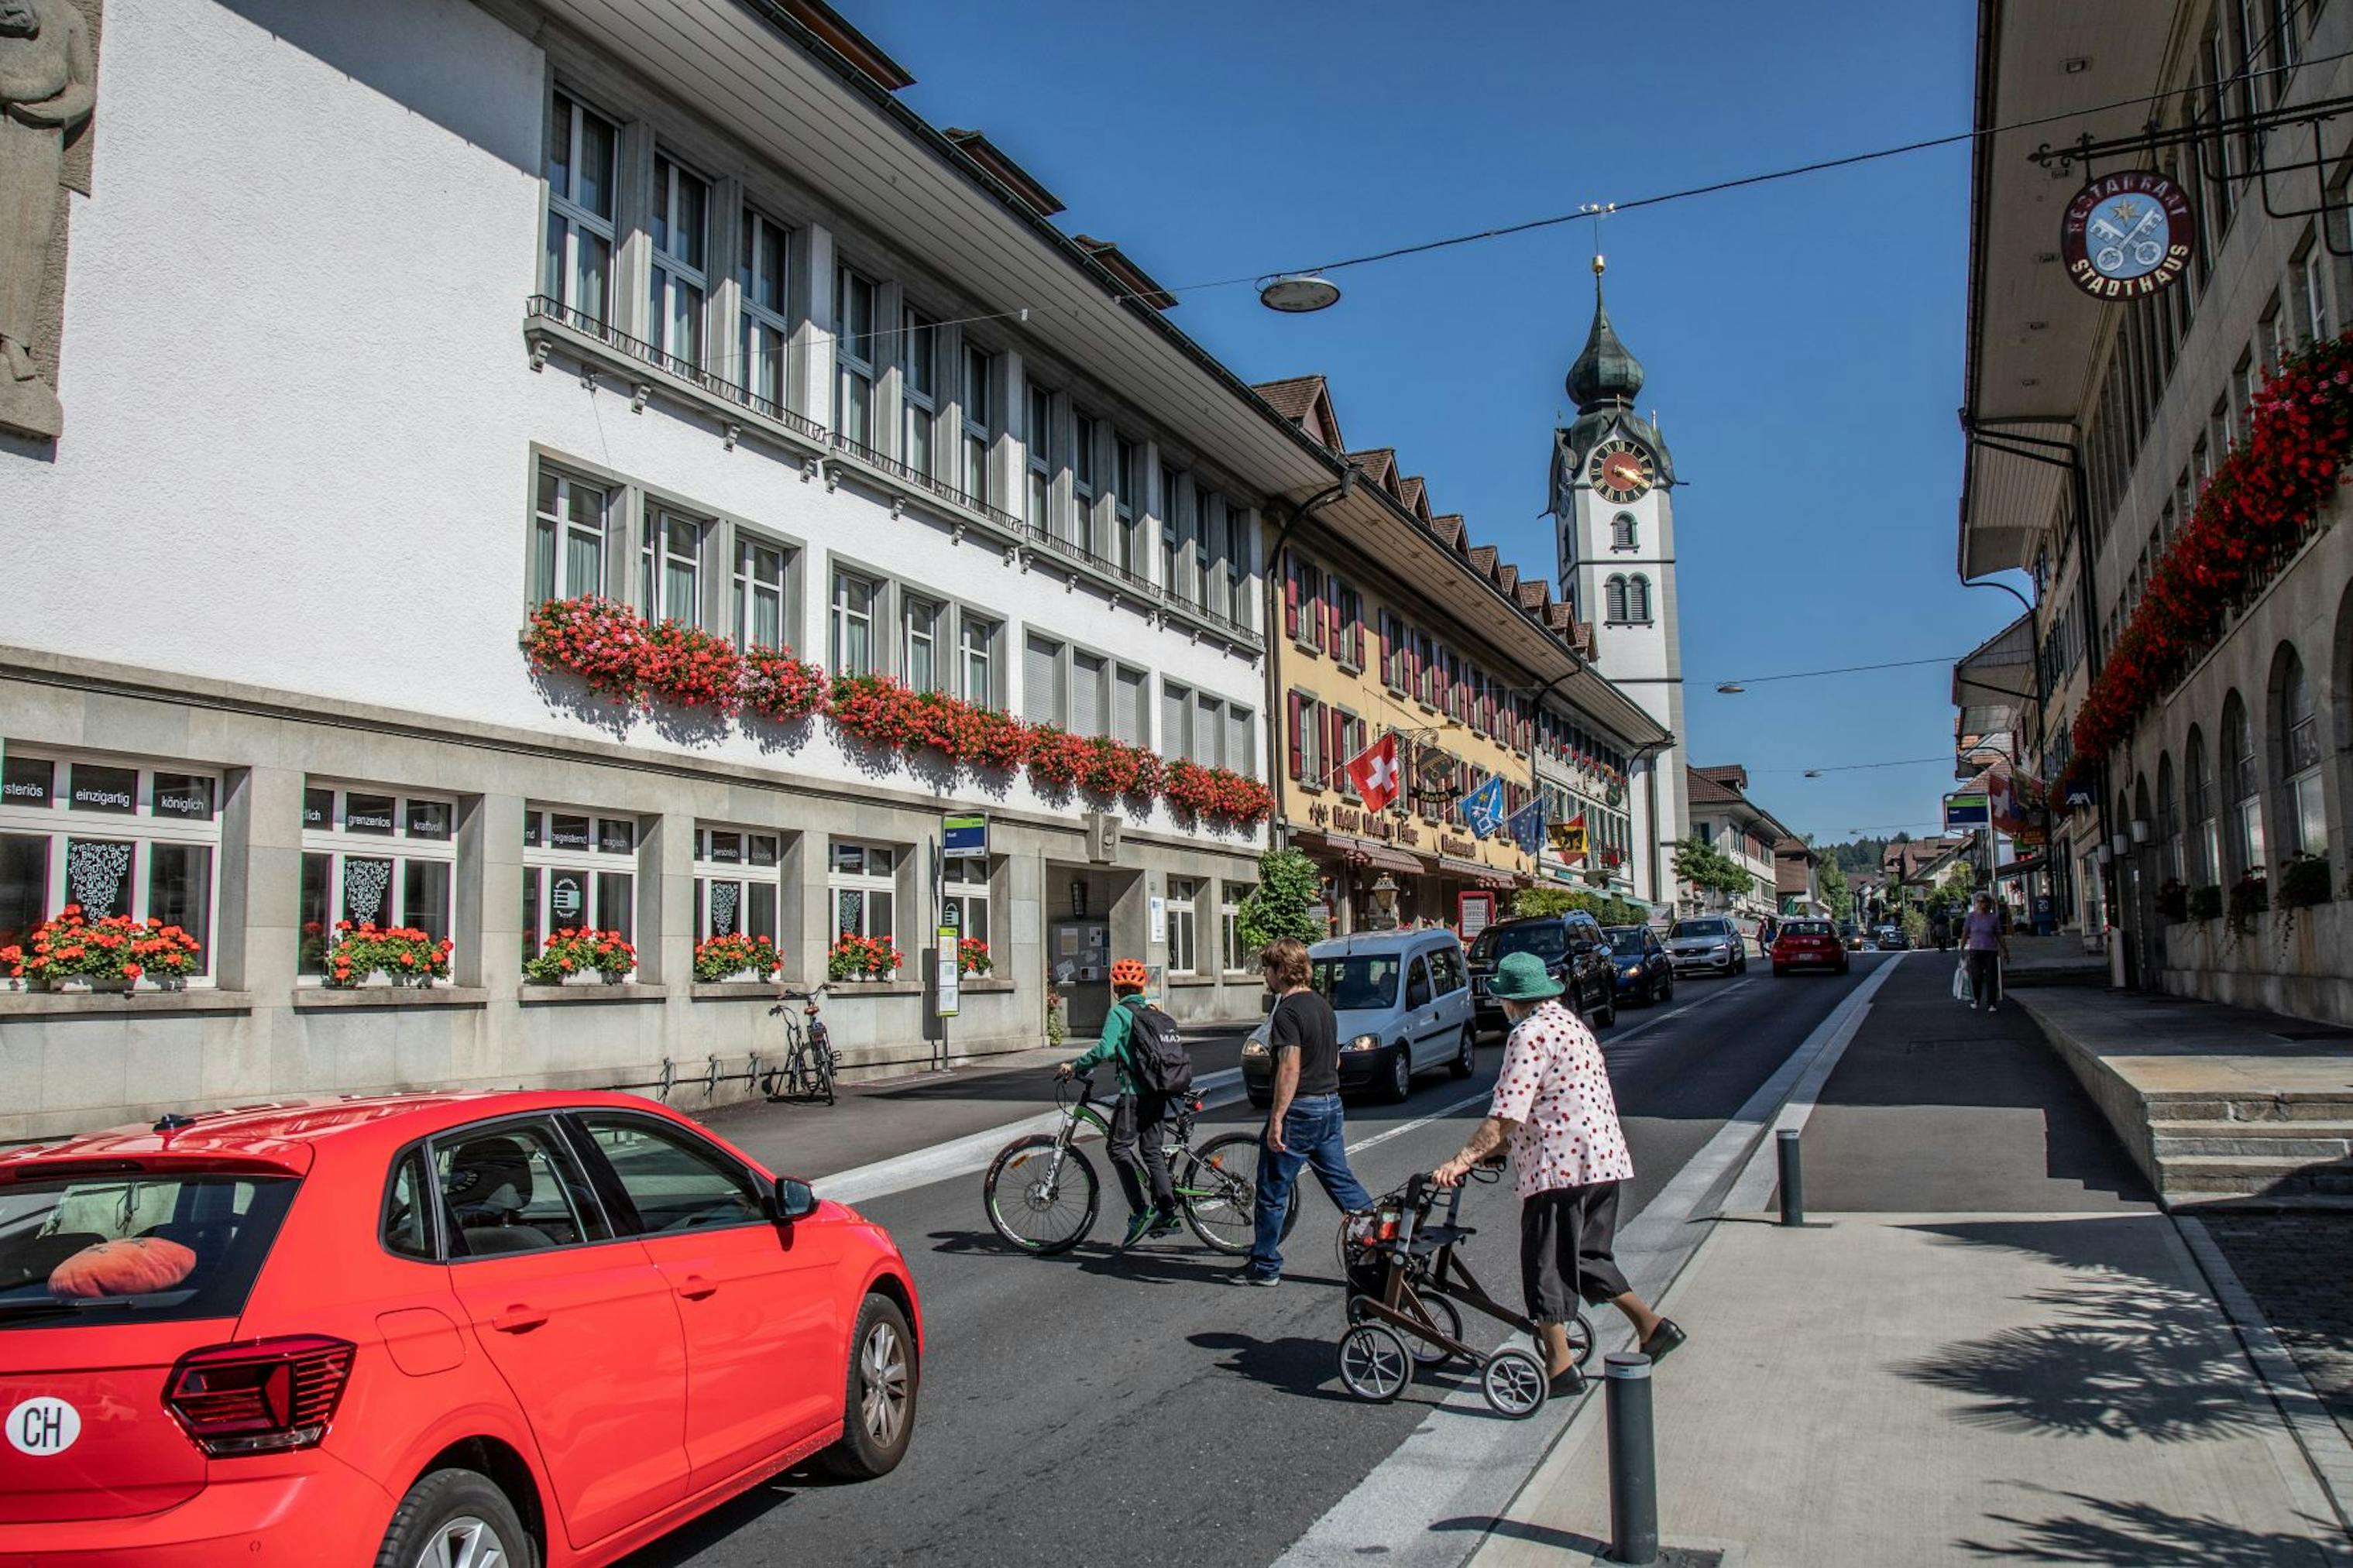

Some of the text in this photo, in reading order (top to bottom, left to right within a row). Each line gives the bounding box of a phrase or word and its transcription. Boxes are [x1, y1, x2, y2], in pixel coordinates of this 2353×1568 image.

[2070, 244, 2189, 297] STADTHAUS
[76, 788, 130, 808] einzigartig
[1419, 791, 1451, 802] Hotel
[2066, 792, 2092, 805] AXA
[160, 795, 204, 813] königlich
[348, 815, 391, 828] grenzenlos
[413, 820, 443, 832] kraftvoll
[2038, 899, 2049, 910] 20
[23, 1405, 62, 1448] CH
